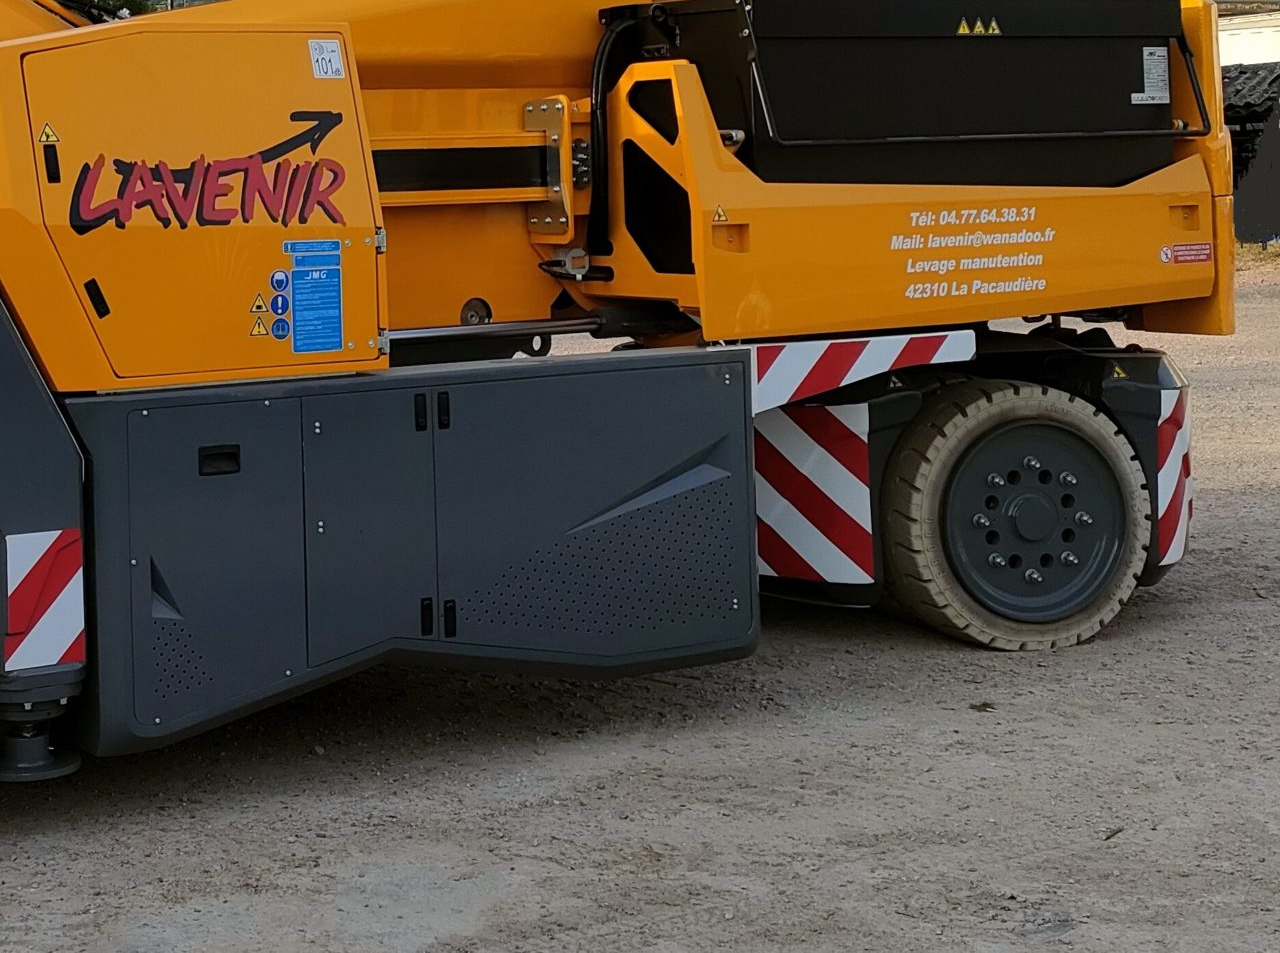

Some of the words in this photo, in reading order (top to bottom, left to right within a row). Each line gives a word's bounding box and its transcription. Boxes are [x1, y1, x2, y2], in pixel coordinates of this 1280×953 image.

[70, 153, 347, 236] LAVENIR
[910, 211, 935, 227] Tél:
[939, 206, 1036, 226] 04.77.64.38.31
[890, 234, 924, 251] Mail:
[928, 227, 1056, 248] lavenir@wanadoo.fr
[906, 258, 956, 275] Levage
[959, 251, 1044, 271] manutention
[304, 270, 328, 280] JMG
[905, 282, 948, 299] 42310
[951, 281, 968, 296] La
[971, 276, 1046, 295] Pacaudière
